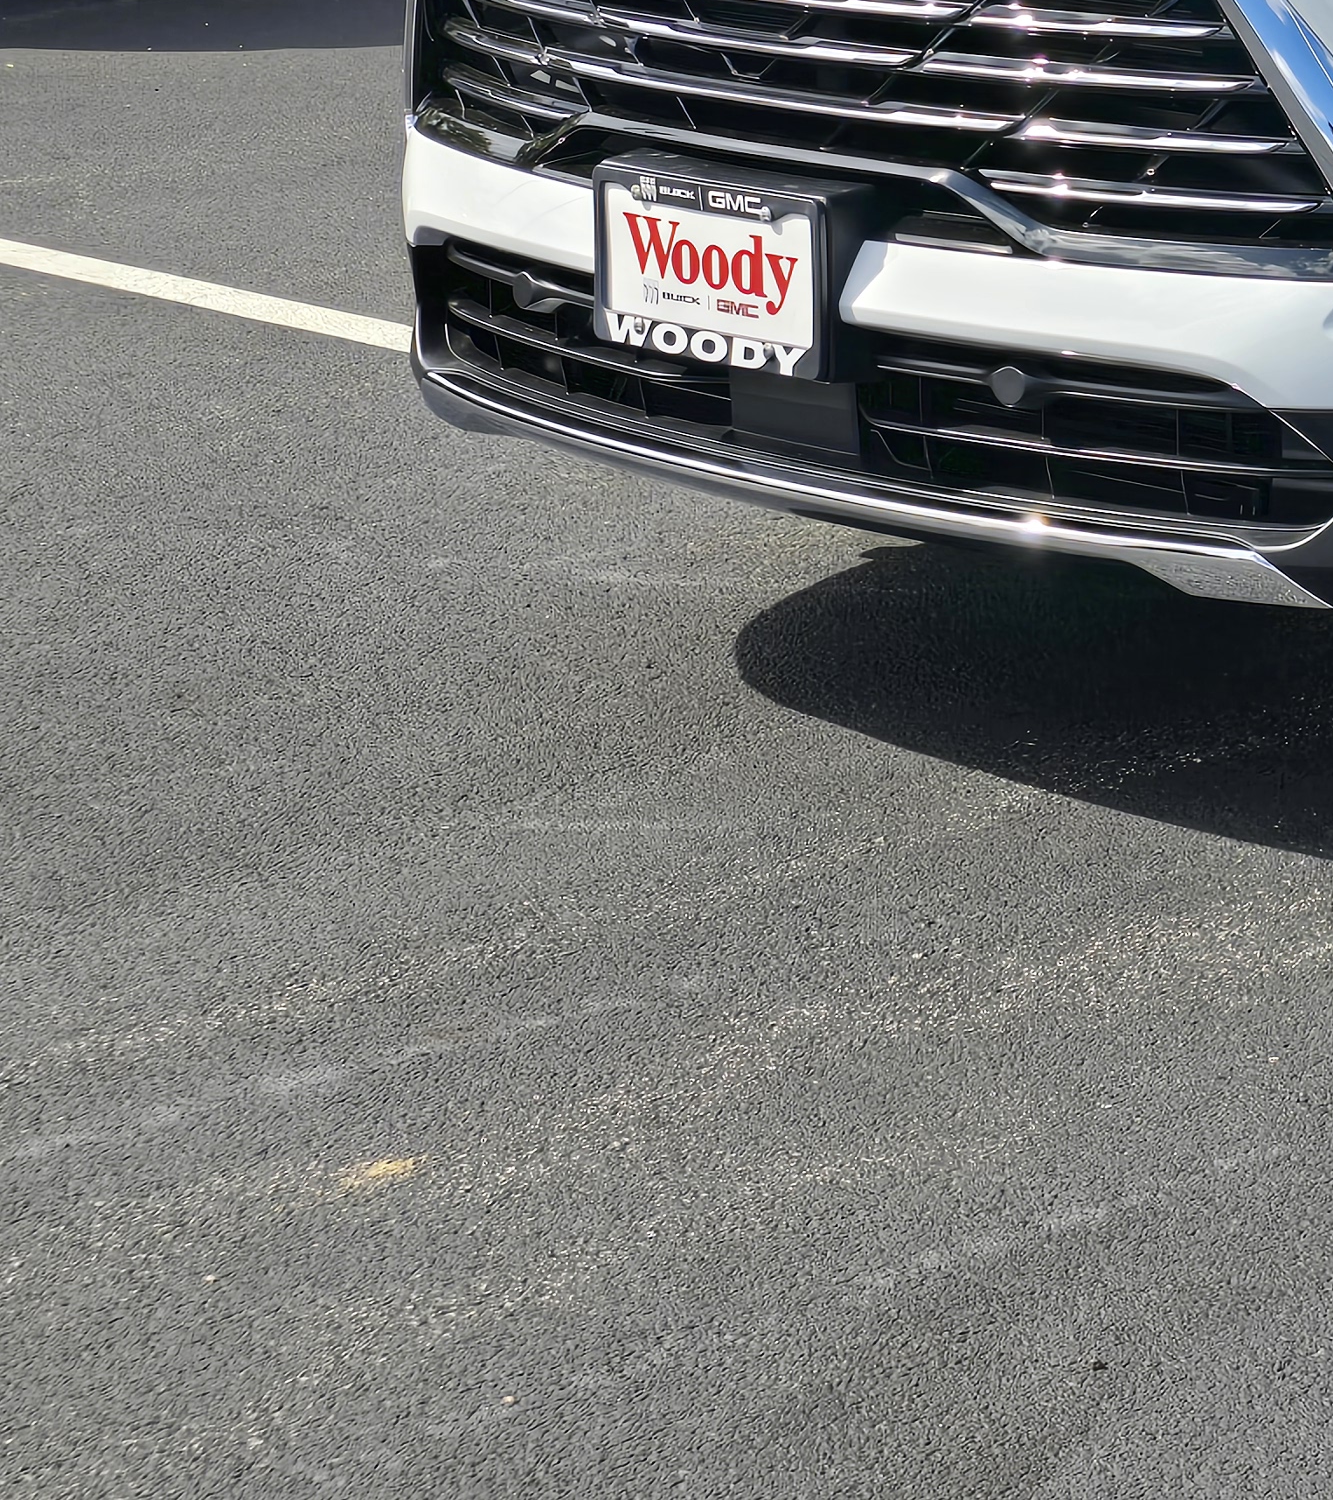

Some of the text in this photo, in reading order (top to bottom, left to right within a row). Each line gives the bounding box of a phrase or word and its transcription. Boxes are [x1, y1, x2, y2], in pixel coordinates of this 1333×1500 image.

[707, 190, 763, 215] GMC
[622, 212, 798, 315] Woody
[662, 291, 760, 319] BUICK GMC
[605, 310, 809, 377] WOODY
